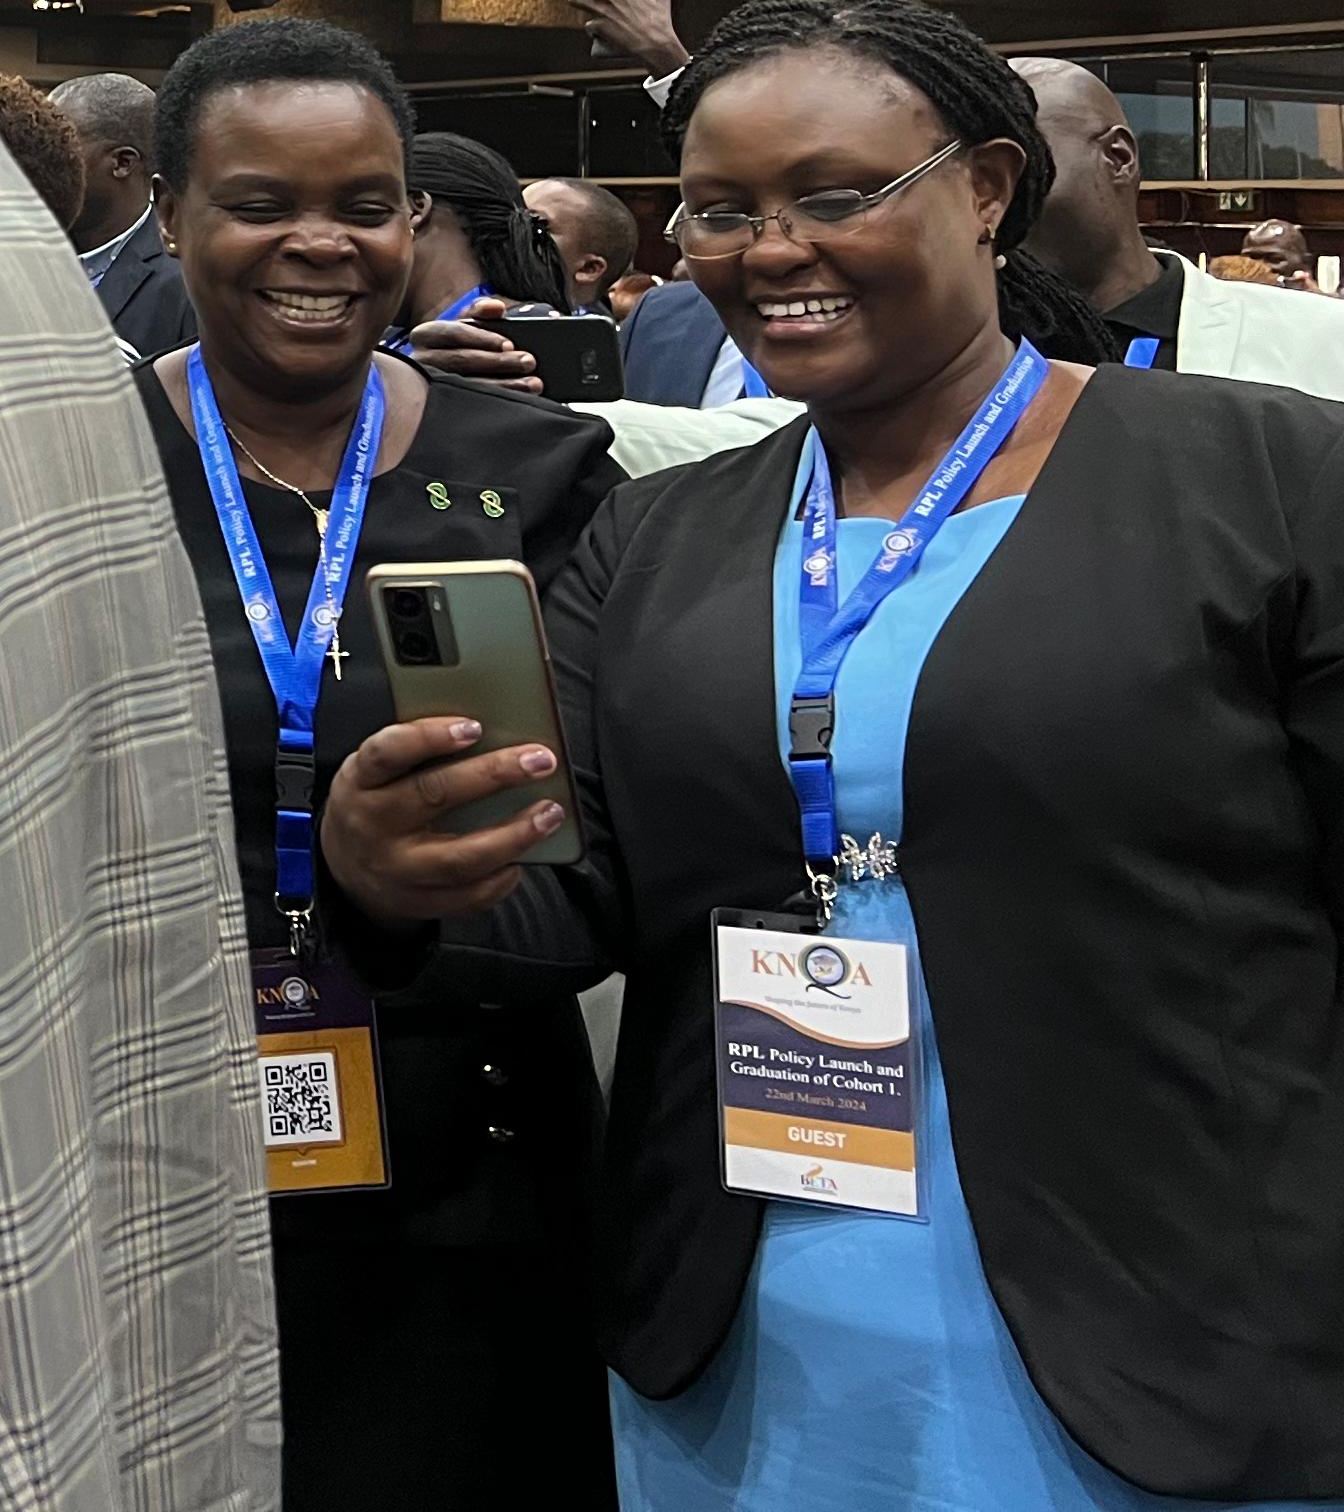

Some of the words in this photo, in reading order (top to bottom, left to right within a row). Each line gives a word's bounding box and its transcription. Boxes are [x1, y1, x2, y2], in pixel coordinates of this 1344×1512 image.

[915, 489, 943, 517] RPL
[934, 456, 967, 490] Policy
[956, 423, 990, 458] Launch
[984, 402, 1003, 424] and
[995, 355, 1035, 405] Graduation
[354, 452, 367, 474] and
[345, 474, 362, 513] Launch
[335, 515, 357, 550] Policy
[240, 546, 256, 578] RPL
[328, 552, 345, 582] RPL
[750, 943, 873, 999] KNQA
[728, 1042, 765, 1059] RPL
[769, 1048, 815, 1068] Policy
[819, 1054, 873, 1074] Launch
[876, 1064, 903, 1078] and
[730, 1061, 810, 1083] Graduation
[813, 1073, 831, 1086] of
[832, 1074, 884, 1094] Cohort
[765, 1087, 794, 1102] 22nd
[788, 1126, 847, 1149] GUEST
